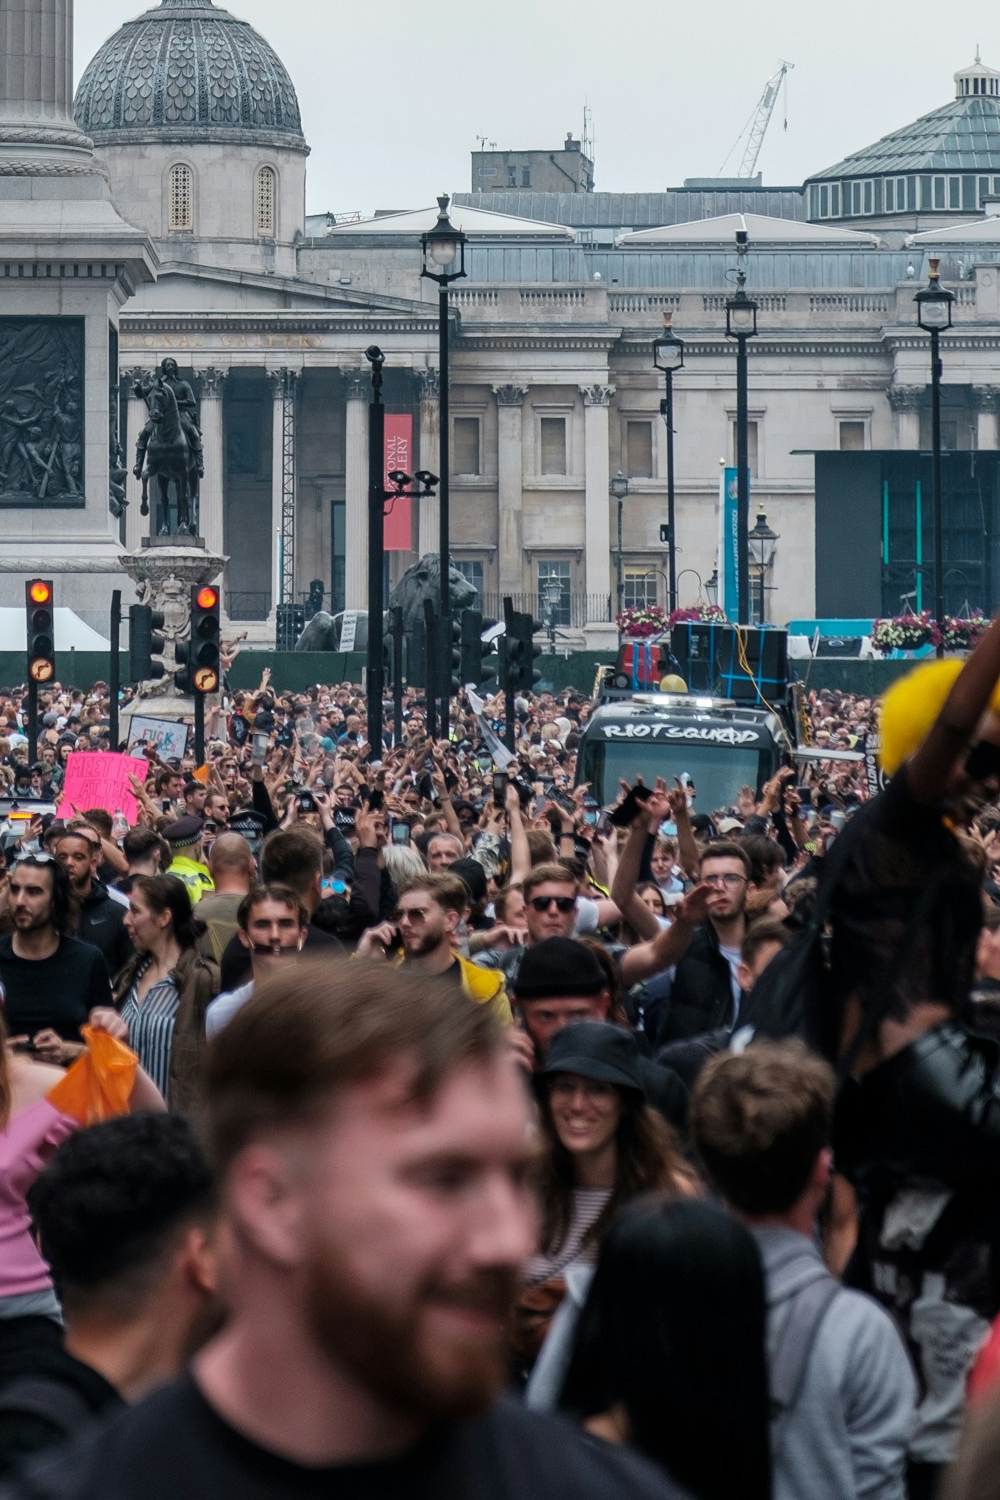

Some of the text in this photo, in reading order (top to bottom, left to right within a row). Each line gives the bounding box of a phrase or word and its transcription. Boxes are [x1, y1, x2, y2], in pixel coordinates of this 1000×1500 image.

[120, 334, 325, 347] IONAL GALLERY
[142, 728, 175, 745] FUCK
[600, 723, 760, 745] RIOT SQUAD
[68, 756, 148, 780] MEET ME
[79, 779, 131, 799] AT THE
